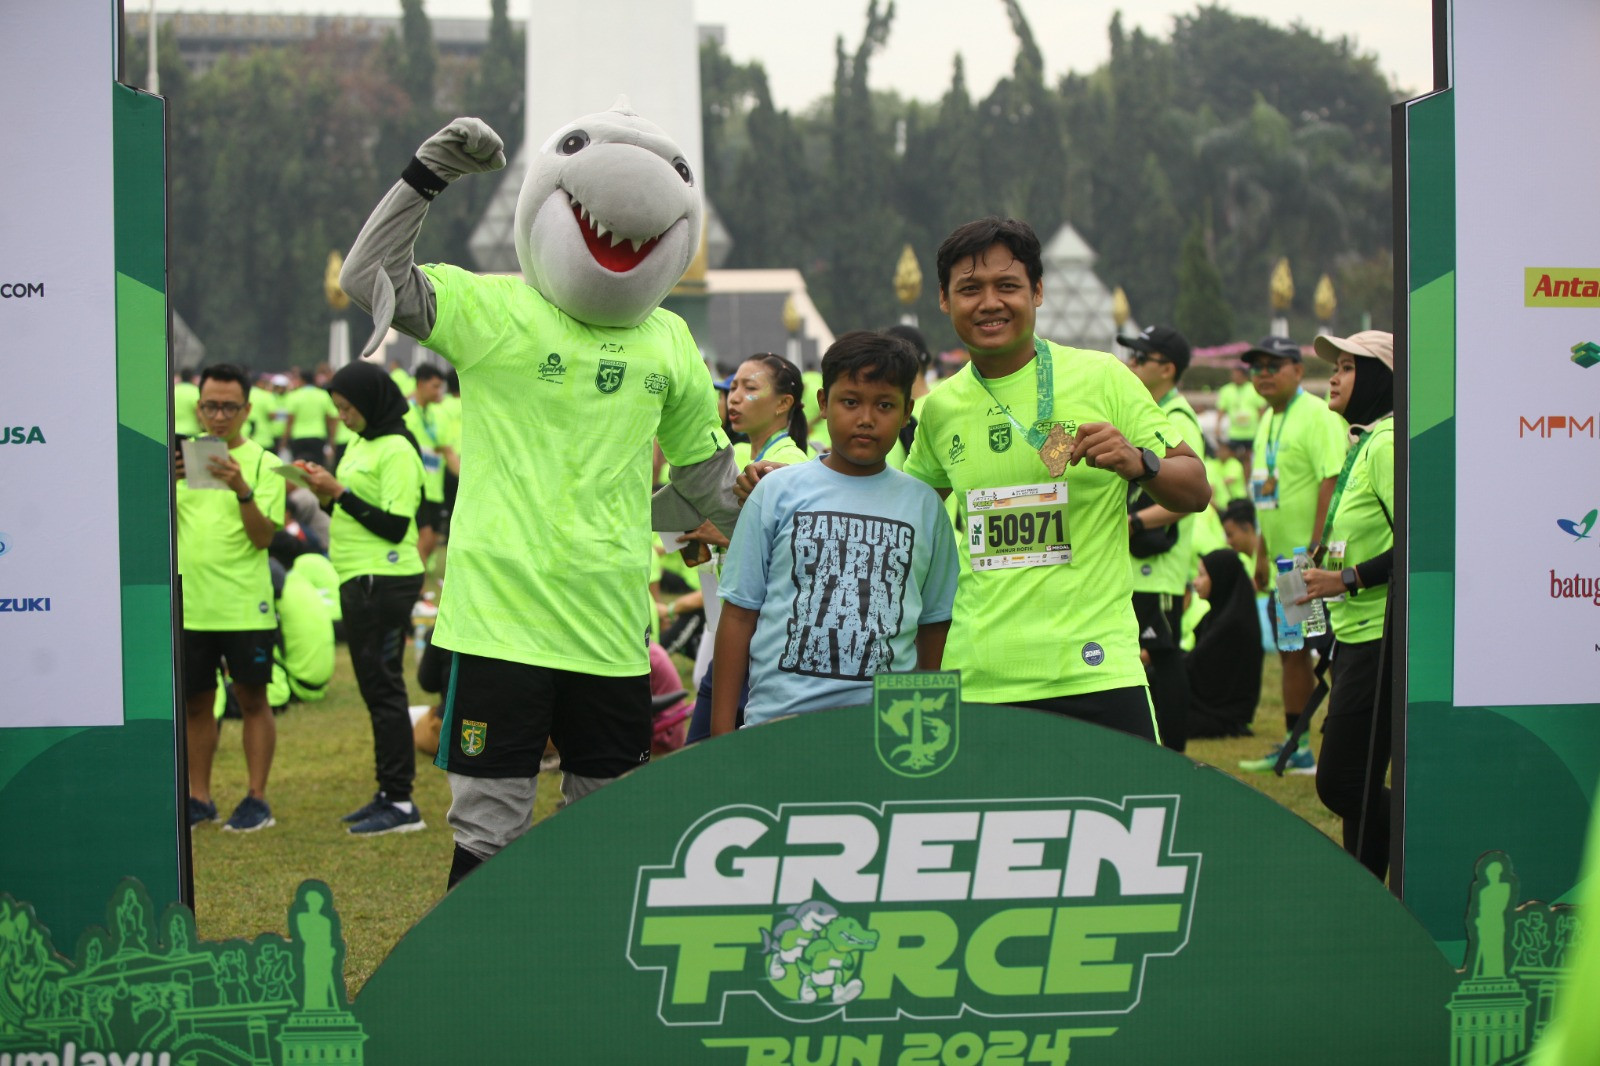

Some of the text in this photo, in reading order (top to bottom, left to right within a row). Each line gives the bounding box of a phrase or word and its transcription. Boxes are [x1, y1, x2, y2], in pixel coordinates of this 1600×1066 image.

[1533, 274, 1600, 298] Anta
[796, 515, 912, 552] BANDUNG
[971, 523, 983, 546] 5K
[988, 510, 1064, 548] 50971
[794, 538, 909, 583] PARIS
[878, 674, 955, 687] PERSEBAYA
[646, 807, 1188, 906] GREEN
[640, 904, 1182, 1004] FRCE
[701, 1027, 1119, 1066] RUN 2024
